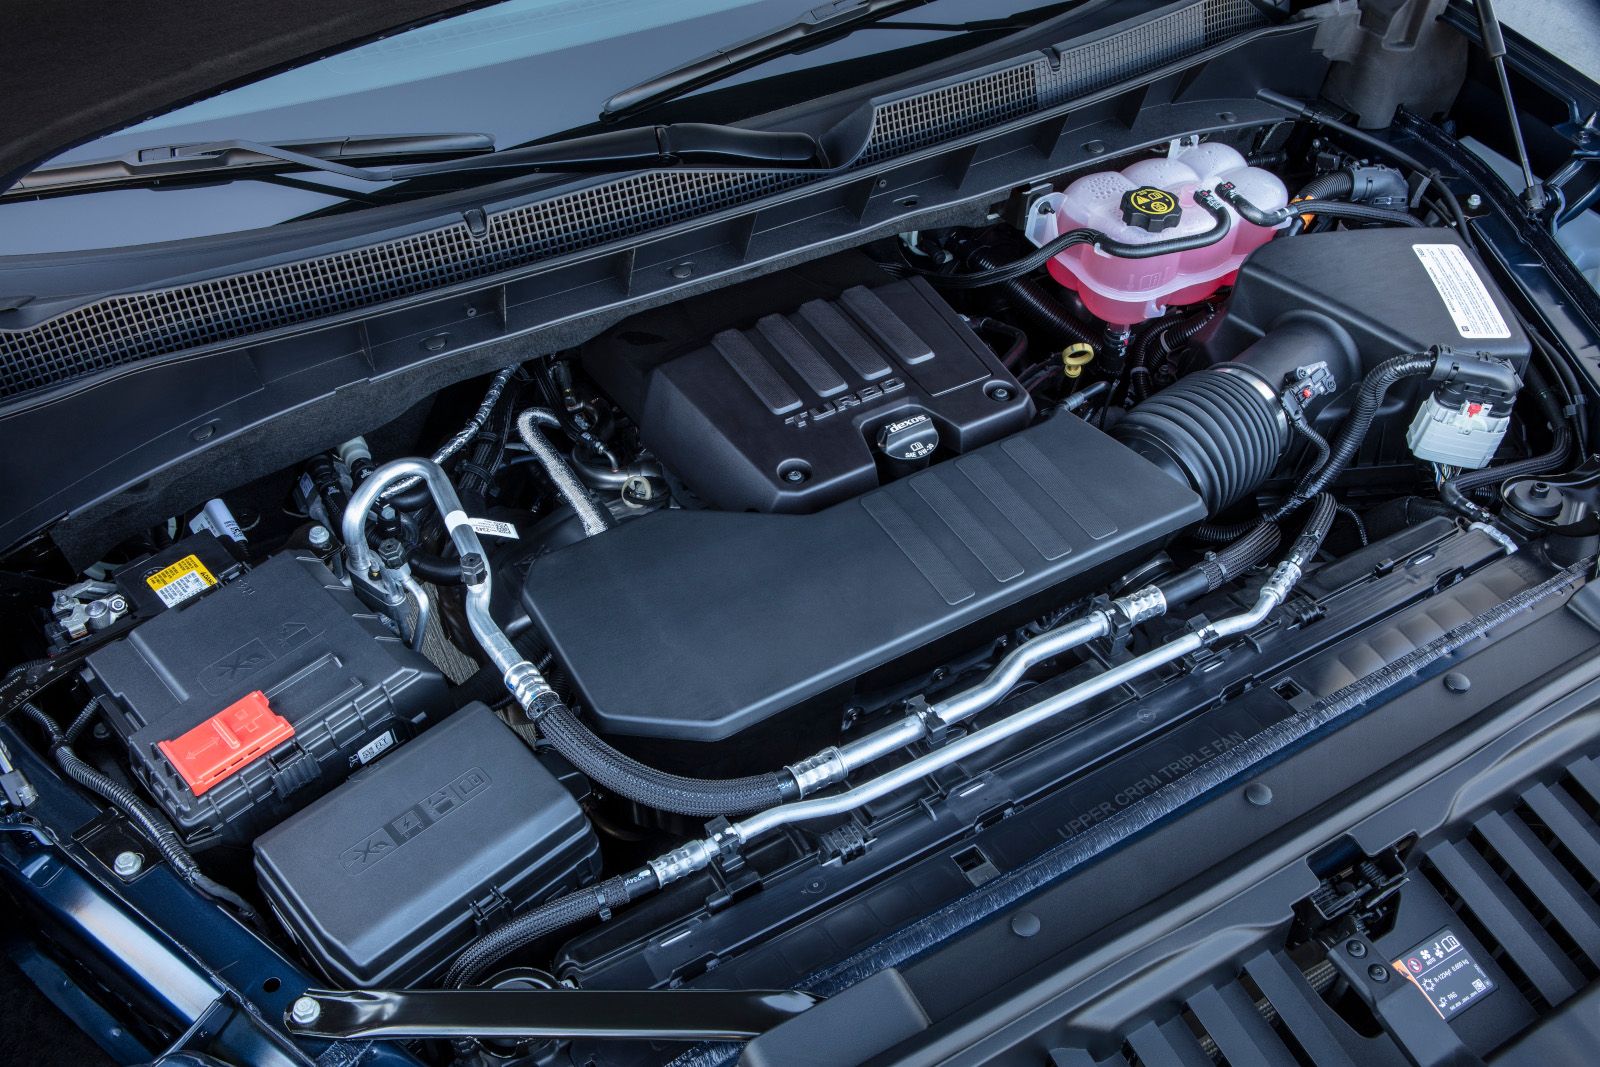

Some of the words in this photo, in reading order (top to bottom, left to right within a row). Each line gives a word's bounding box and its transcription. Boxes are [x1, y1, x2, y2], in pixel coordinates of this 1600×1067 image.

[785, 377, 906, 428] TURBO
[889, 414, 926, 433] dexos
[1056, 801, 1116, 839] UPPER
[1113, 775, 1162, 806] CRFM
[1158, 746, 1213, 779] TRIPLE
[1212, 730, 1246, 754] FAN
